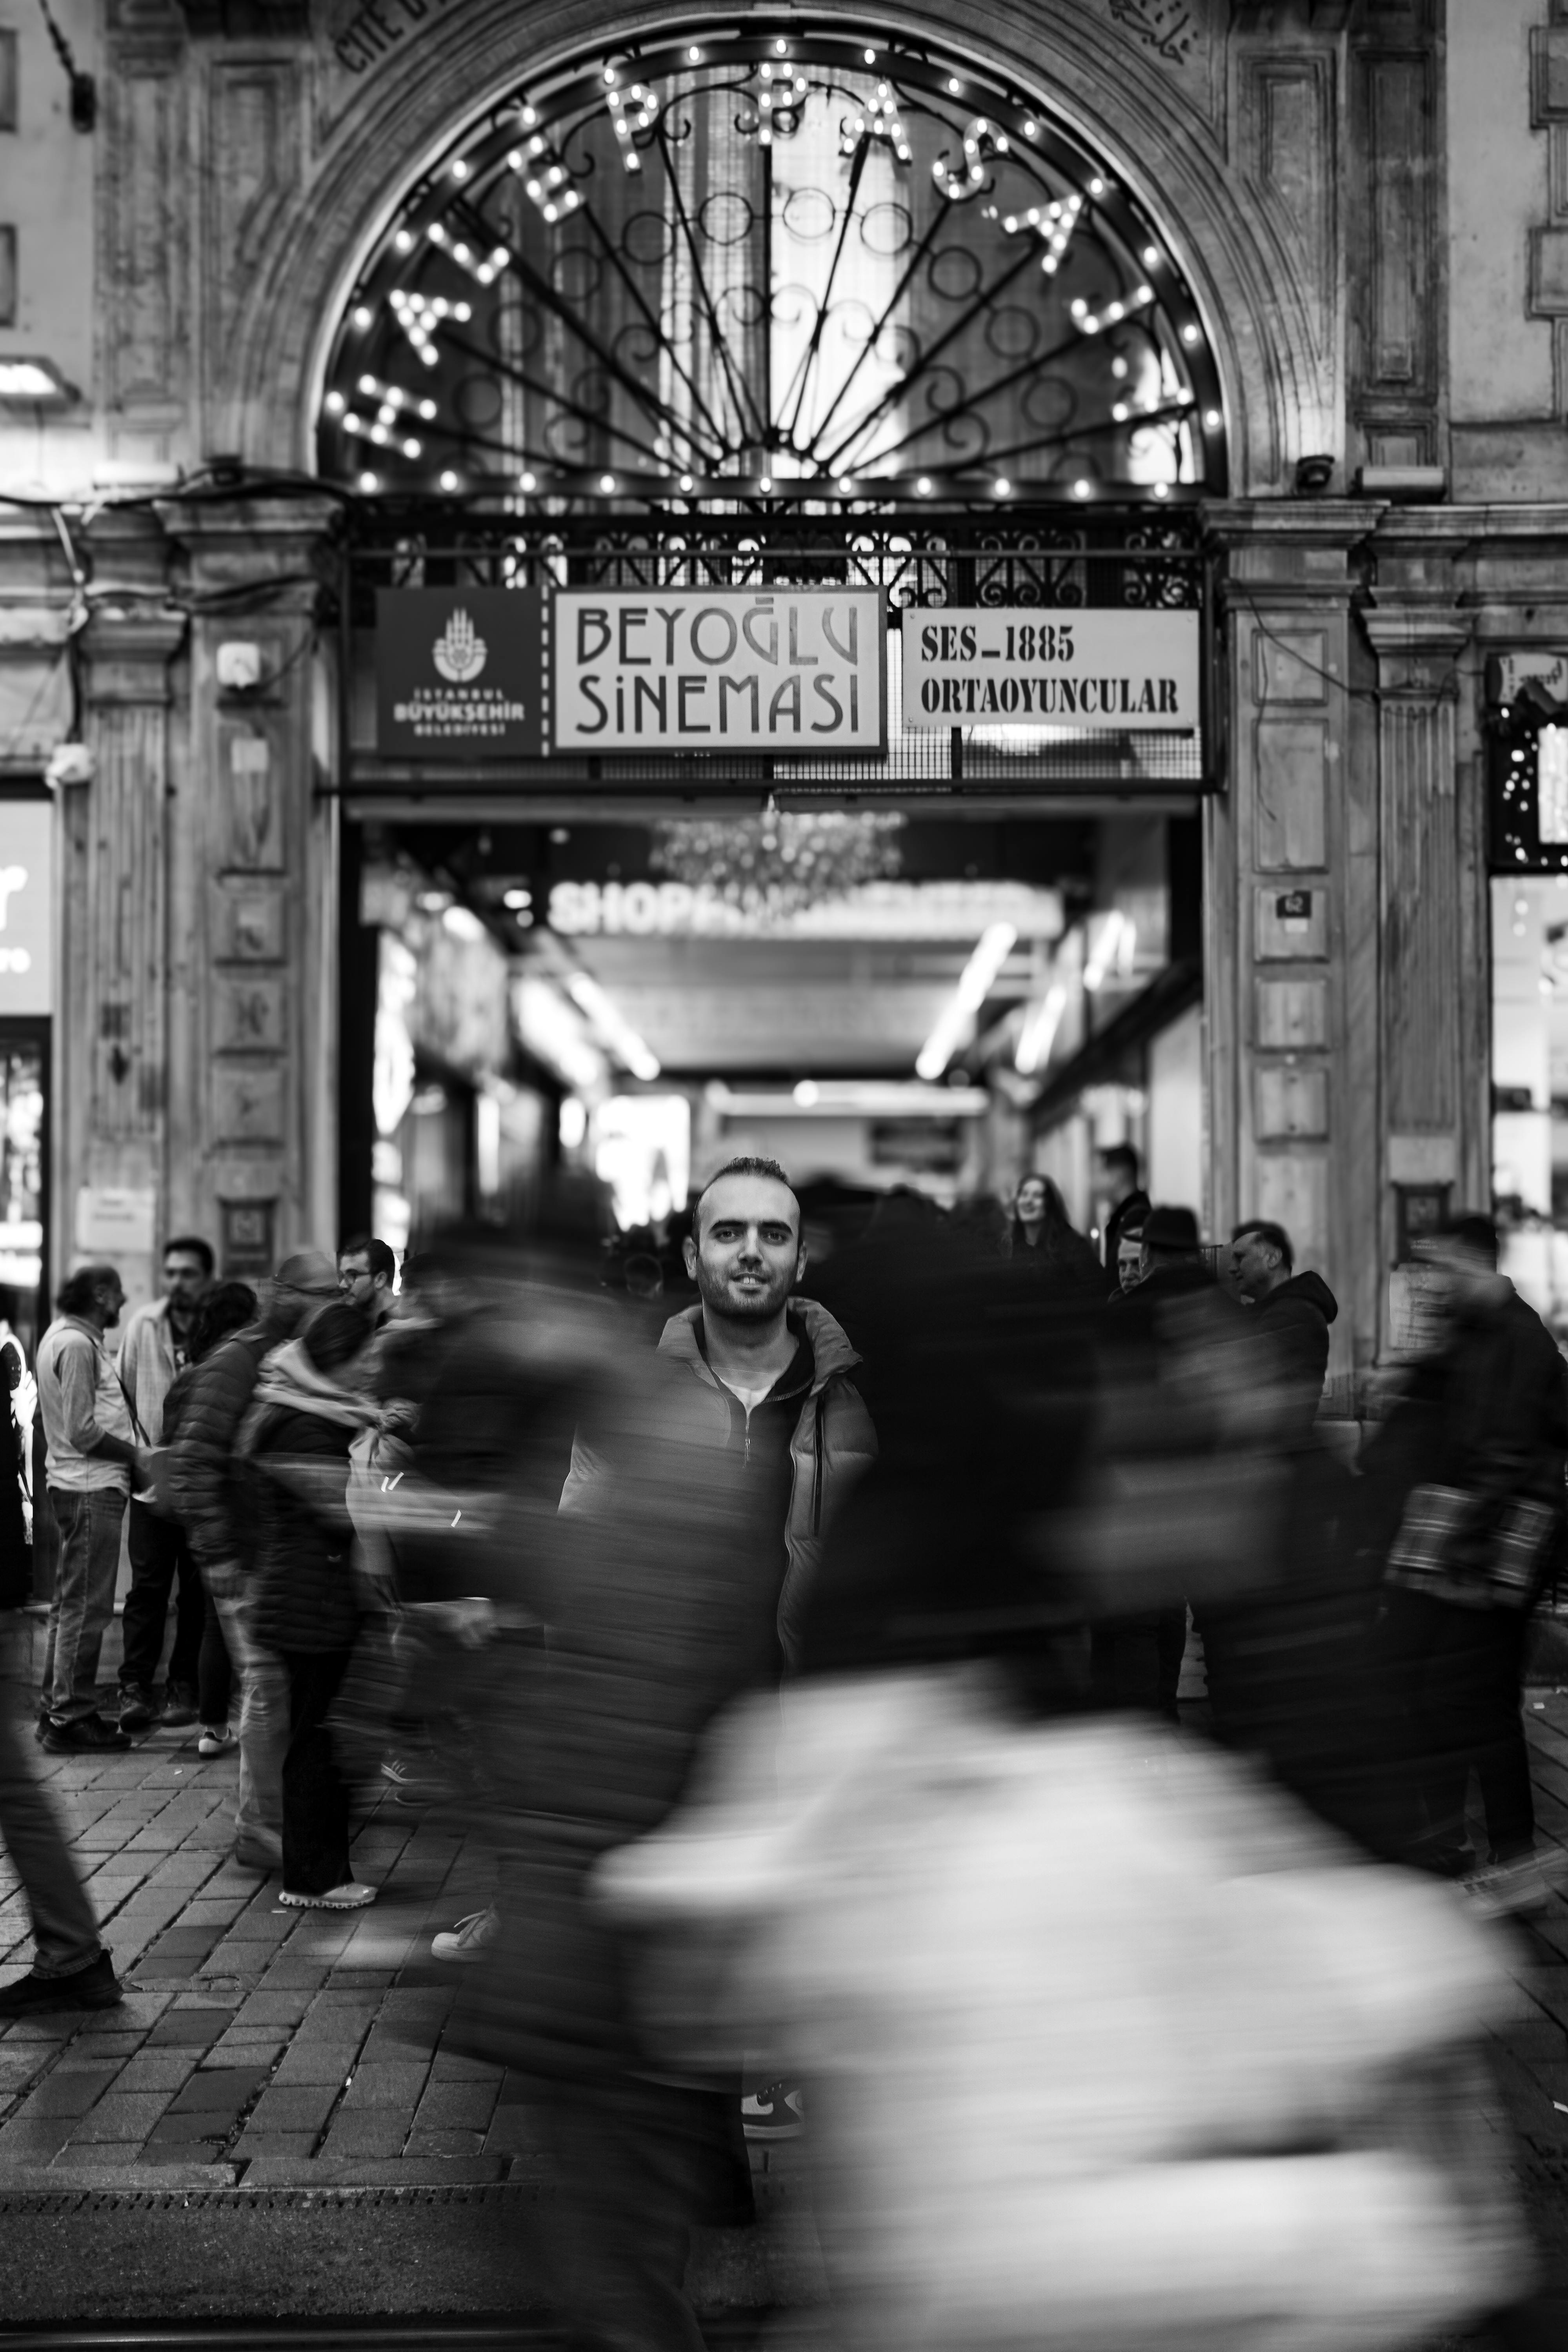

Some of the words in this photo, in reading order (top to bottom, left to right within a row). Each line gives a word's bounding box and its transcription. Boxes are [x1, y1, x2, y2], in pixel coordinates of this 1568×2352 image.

[340, 81, 659, 460] HALEP
[577, 597, 858, 666] BEYOĞLU
[921, 679, 1179, 714] ORTAOYUNCULAR
[1285, 895, 1303, 913] 62
